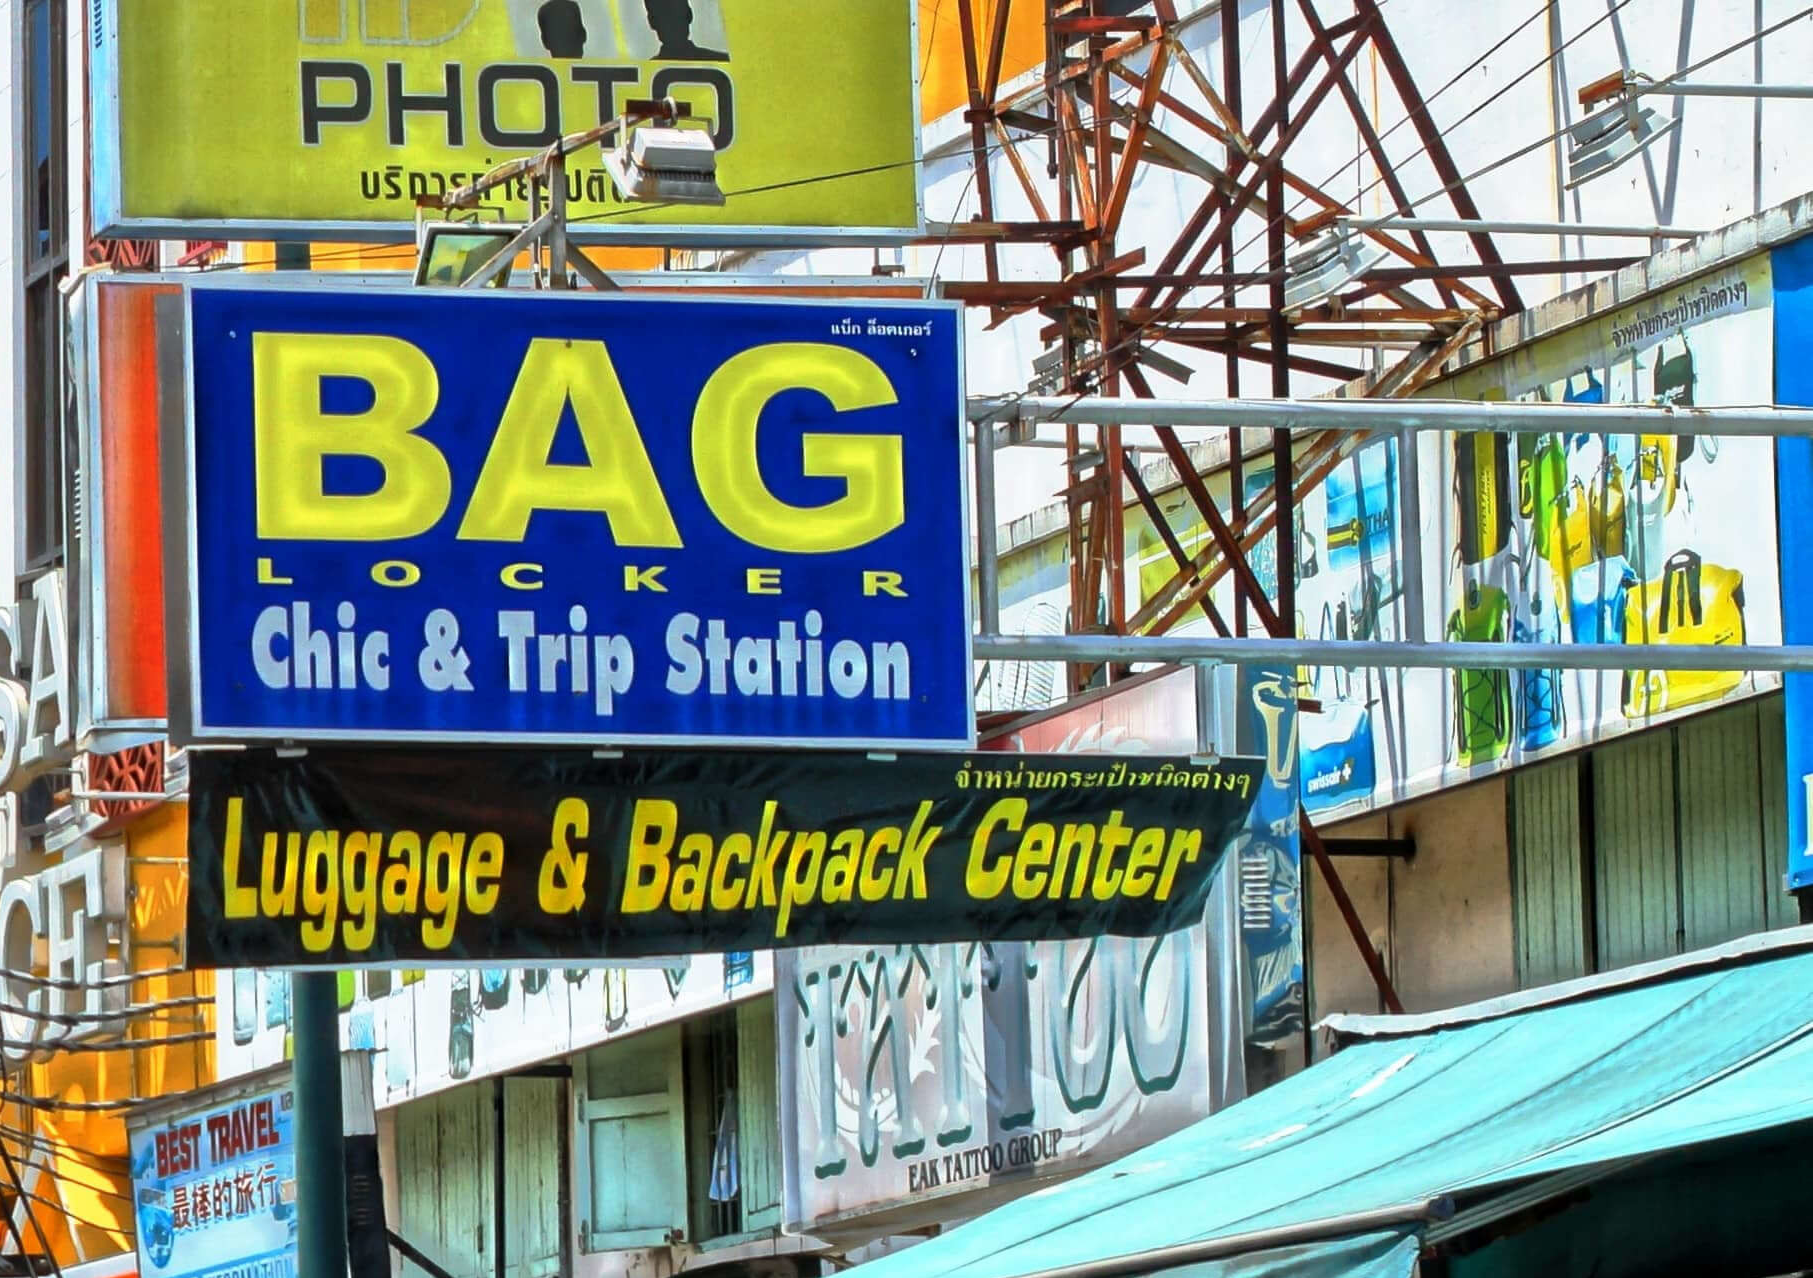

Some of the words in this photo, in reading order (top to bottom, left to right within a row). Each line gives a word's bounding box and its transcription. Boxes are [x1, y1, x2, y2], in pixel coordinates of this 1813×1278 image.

[301, 60, 735, 153] PHOTO
[252, 329, 907, 553] BAG
[258, 557, 909, 598] LOCKER
[251, 600, 391, 693] Chic
[418, 608, 475, 692] &
[497, 604, 635, 717] Trip
[665, 609, 912, 703] Station
[221, 796, 505, 953] Luggage
[537, 796, 590, 917] &
[621, 797, 946, 938] Backpack
[964, 796, 1203, 904] Center
[155, 1123, 203, 1178] BEST
[207, 1099, 280, 1162] TRAVEL
[908, 1156, 941, 1192] EAK
[943, 1143, 1003, 1183] TATTOO
[1008, 1127, 1063, 1168] GROUP
